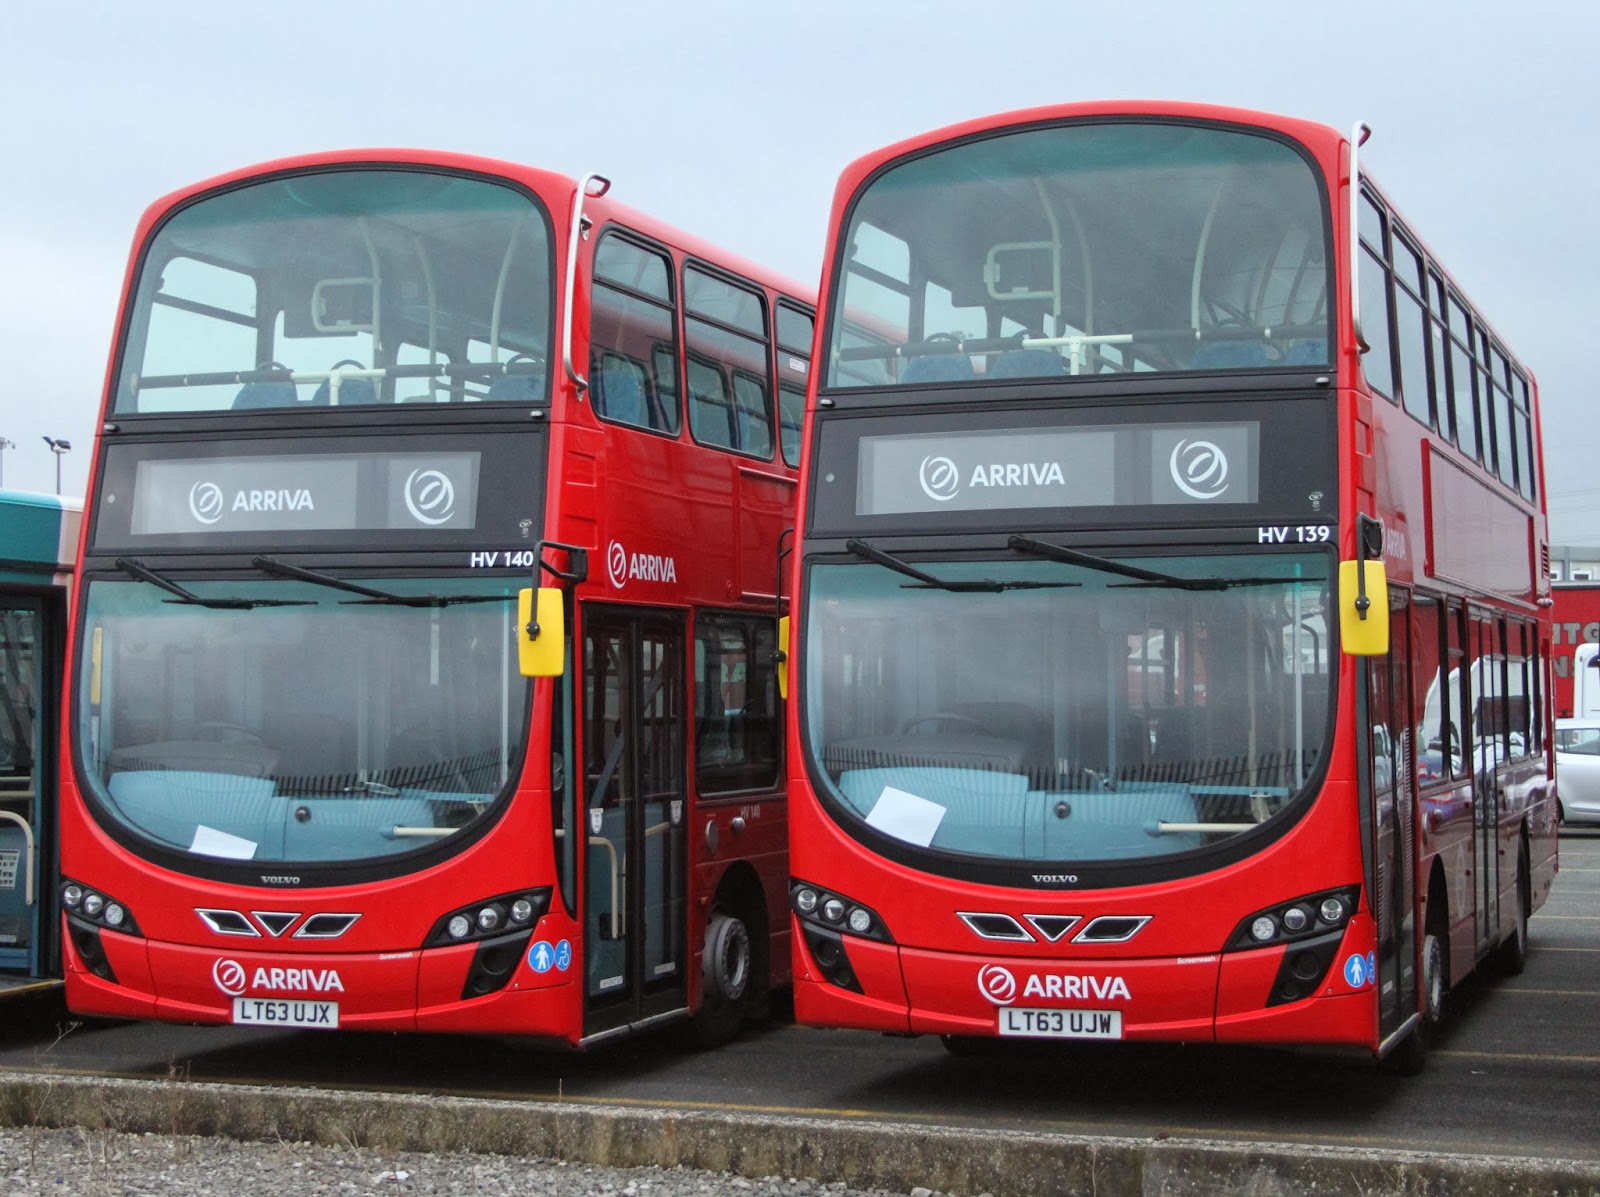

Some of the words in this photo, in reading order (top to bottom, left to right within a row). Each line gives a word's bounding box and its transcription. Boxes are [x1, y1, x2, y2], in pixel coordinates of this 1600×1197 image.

[969, 462, 1065, 487] ARRIVA
[232, 489, 314, 512] ARRIVA
[1258, 527, 1288, 543] HV
[1296, 525, 1330, 542] 139
[470, 551, 498, 568] HV
[504, 551, 533, 567] 140
[629, 552, 677, 583] ARRIVA
[261, 875, 301, 884] VOLVO
[1032, 874, 1078, 883] VOLVO
[379, 952, 413, 960] Screenwash
[1177, 955, 1216, 964] Screenwash
[252, 967, 345, 992] ARRIVA
[1023, 974, 1132, 1000] ARRIVA
[240, 1002, 289, 1022] LT63
[294, 1004, 330, 1024] UJX
[1008, 1011, 1063, 1031] LT63
[1070, 1011, 1112, 1033] UJW
